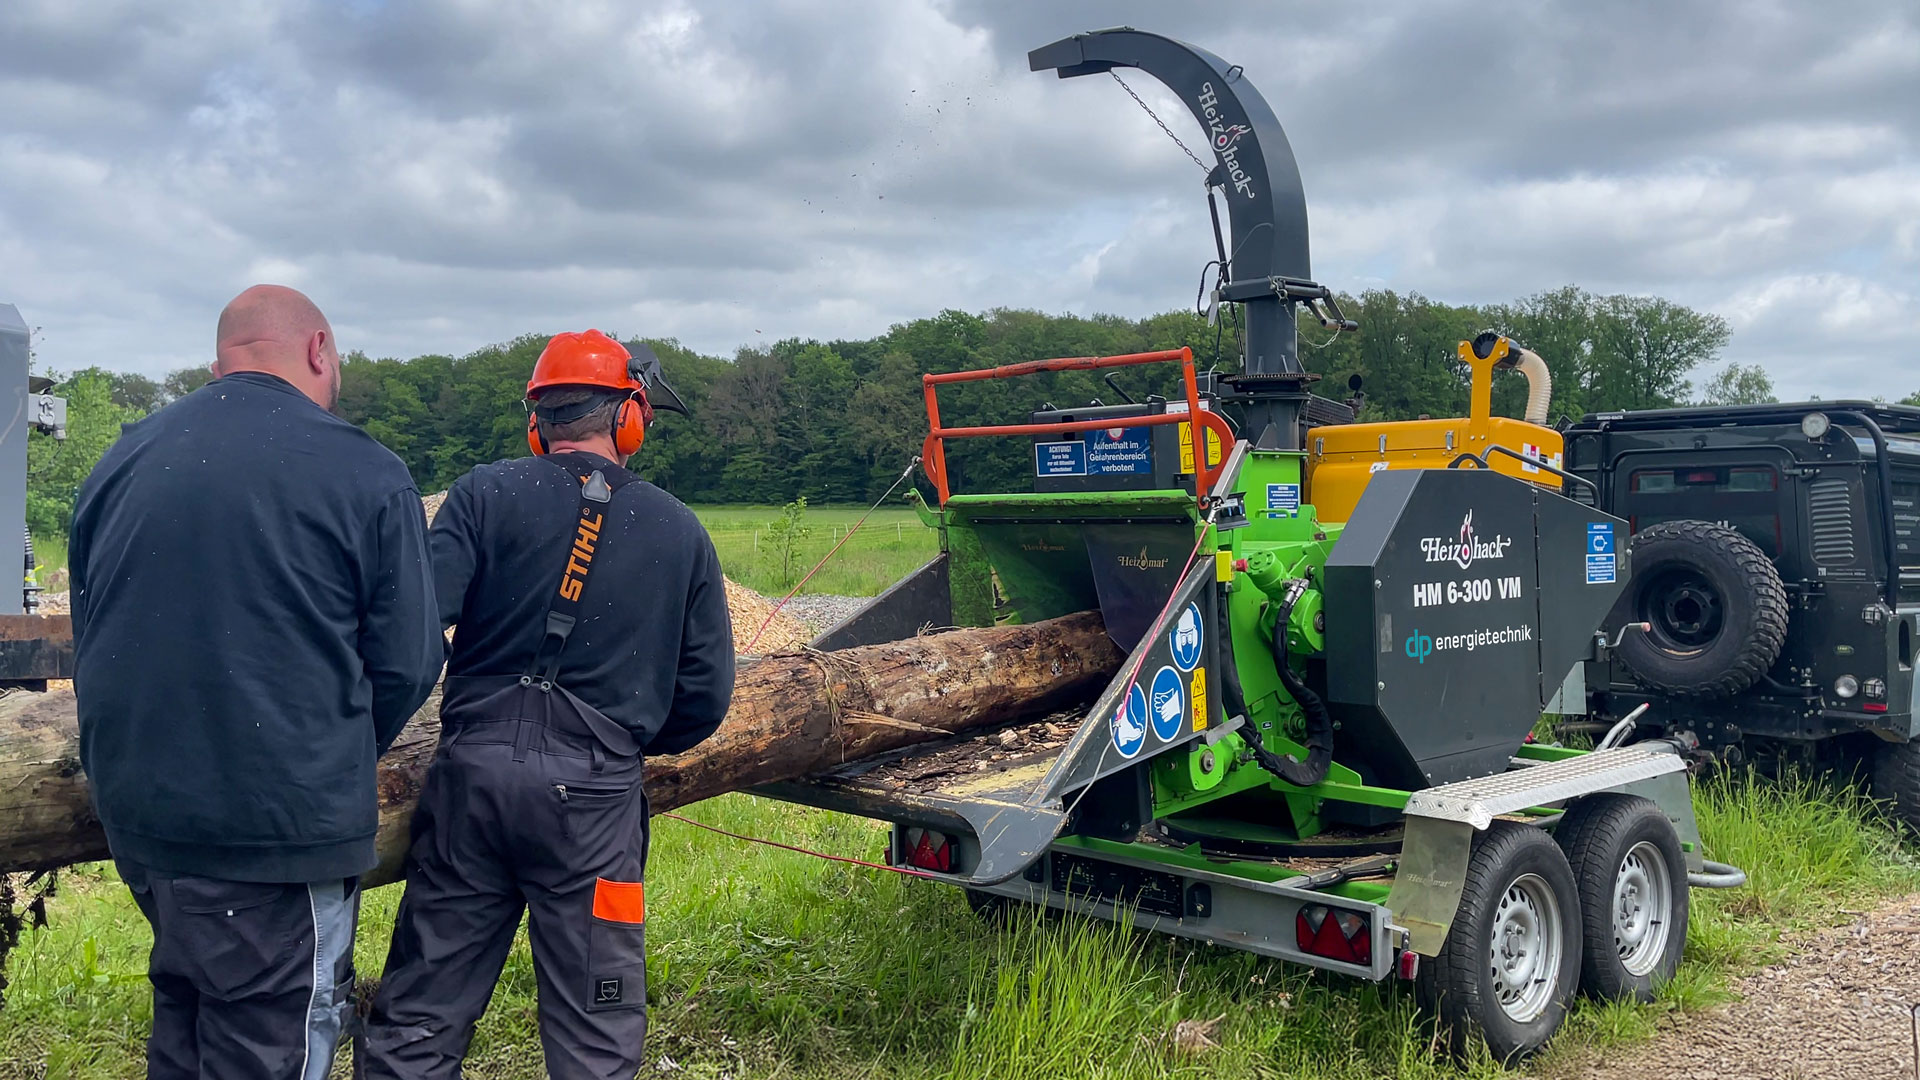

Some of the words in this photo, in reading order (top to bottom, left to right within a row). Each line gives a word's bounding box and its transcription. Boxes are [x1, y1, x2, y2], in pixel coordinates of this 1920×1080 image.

[1093, 440, 1129, 450] Aufenthalt
[1129, 441, 1139, 449] im
[1089, 451, 1147, 462] Gefahrenbereich
[1101, 463, 1135, 472] verboten!
[1413, 582, 1443, 607] HM
[1447, 578, 1492, 604] 6-300
[1497, 576, 1522, 599] VM
[1405, 629, 1432, 664] dp
[1435, 624, 1532, 651] energietechnik
